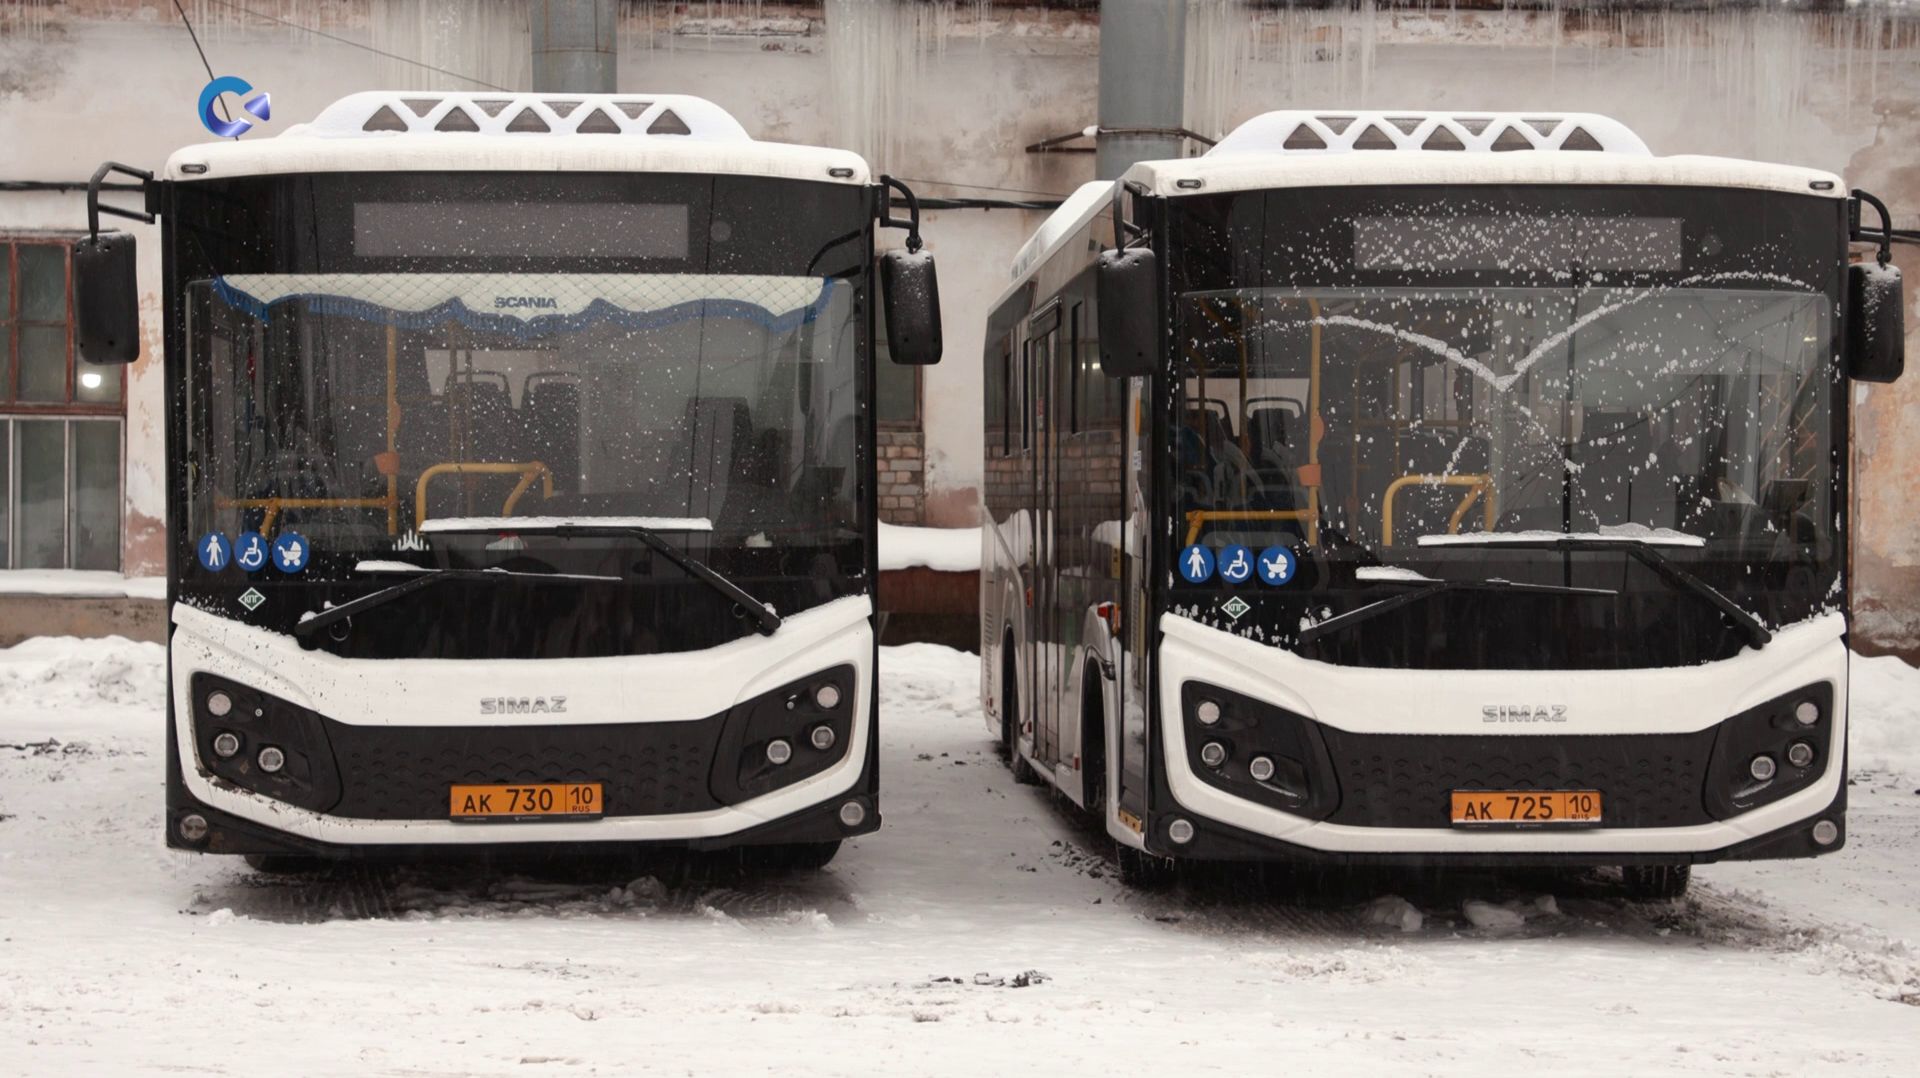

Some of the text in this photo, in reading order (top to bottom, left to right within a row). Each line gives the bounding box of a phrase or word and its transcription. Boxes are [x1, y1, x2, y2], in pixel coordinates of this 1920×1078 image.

[494, 296, 558, 309] SCANIA
[480, 696, 567, 714] SIMAZ
[1482, 704, 1568, 723] SIMAZ
[463, 786, 593, 813] AK 730 10
[1464, 795, 1592, 820] AK 725 10
[572, 805, 590, 813] RUS
